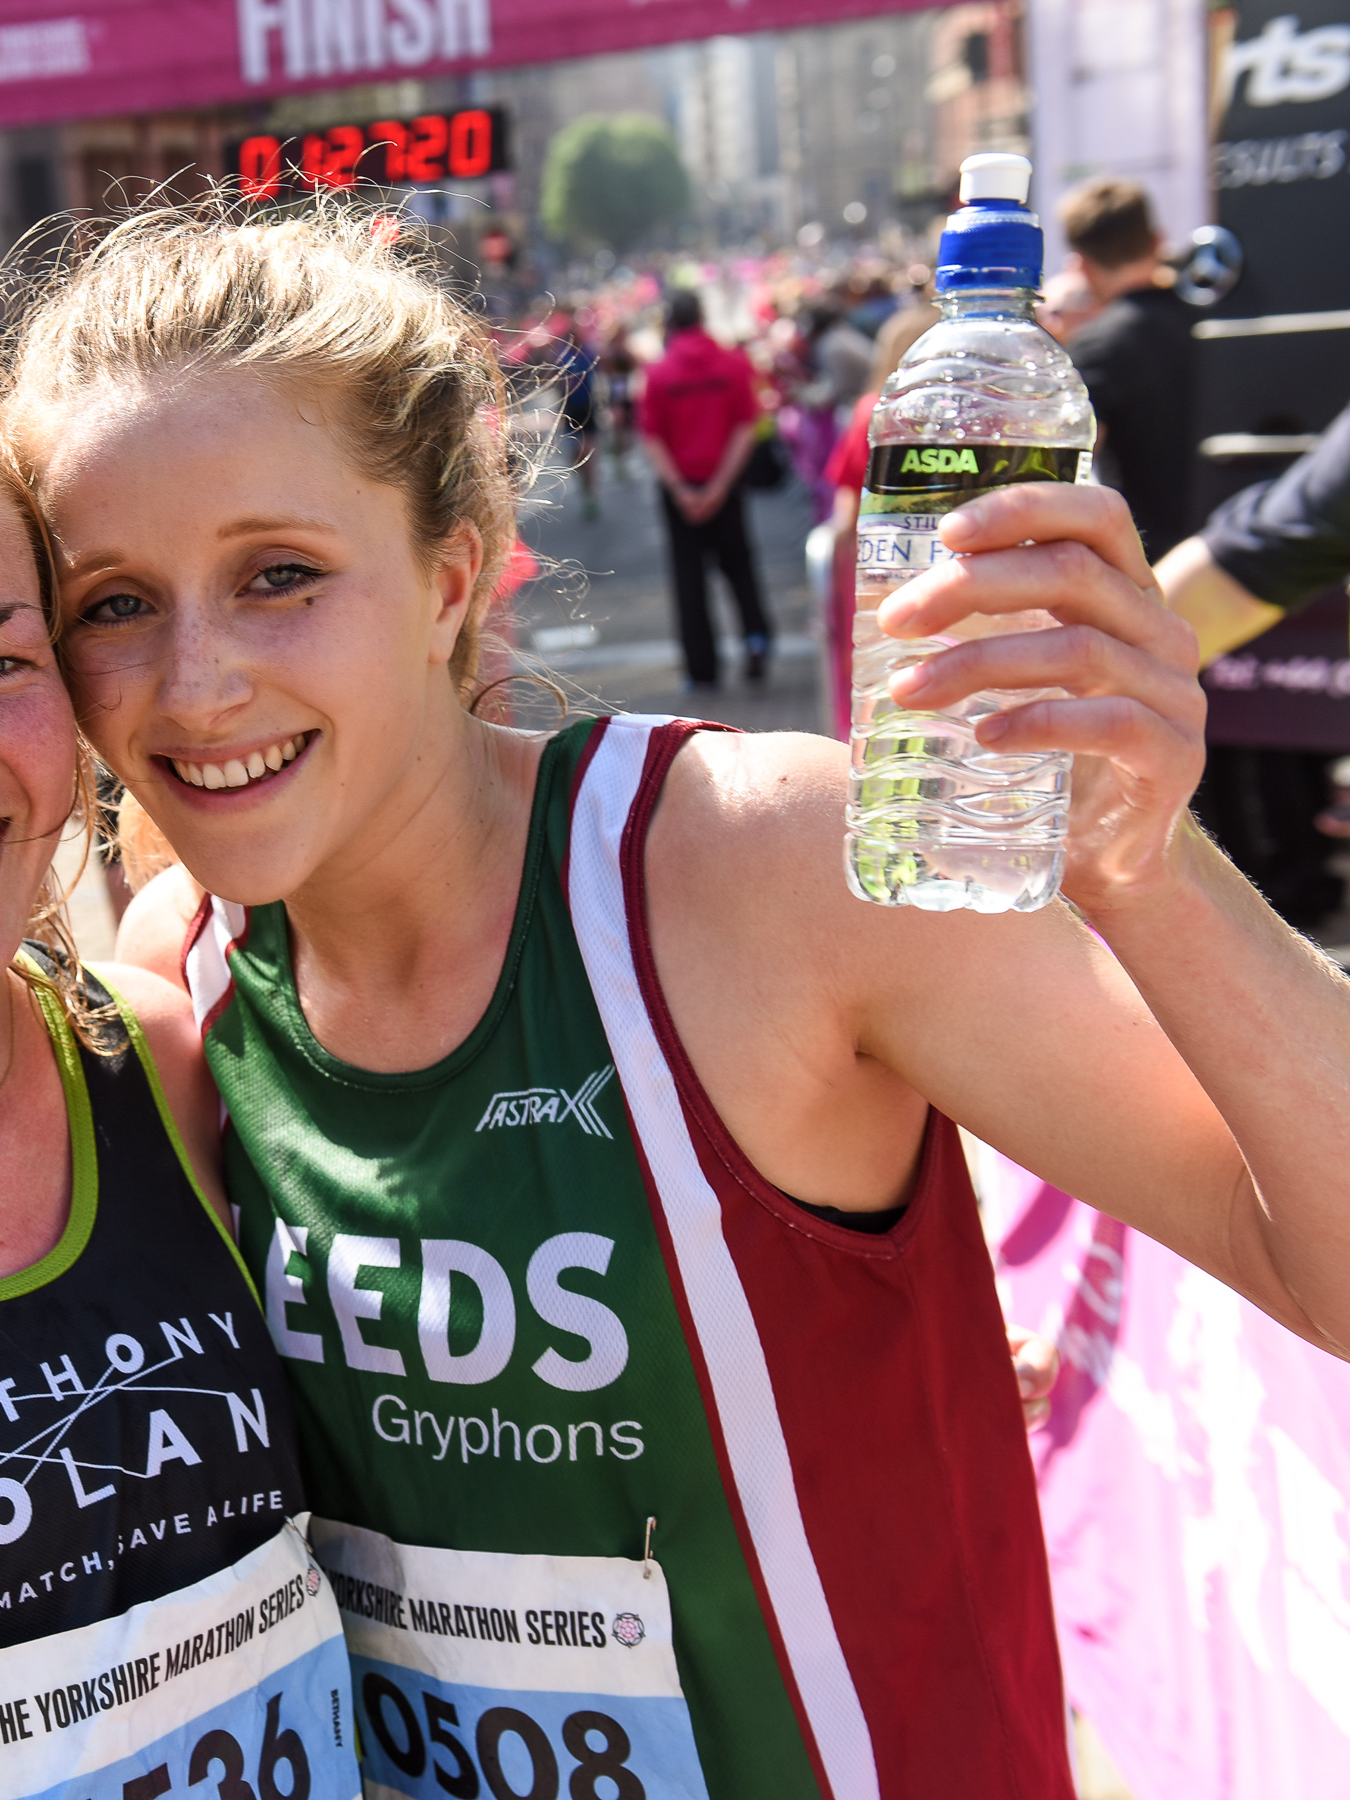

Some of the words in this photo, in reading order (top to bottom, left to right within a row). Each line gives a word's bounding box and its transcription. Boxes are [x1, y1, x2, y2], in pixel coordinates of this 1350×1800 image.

[238, 0, 492, 84] FINISH
[901, 448, 980, 474] ASDA
[372, 1394, 645, 1464] Gryphons
[34, 1652, 161, 1733] YORKSHIRE
[164, 1606, 255, 1682] MARATHON
[259, 1574, 305, 1634] SERIES
[408, 1598, 521, 1643] MARATHON
[525, 1609, 607, 1648] SERIES
[354, 1672, 646, 1800] 0508
